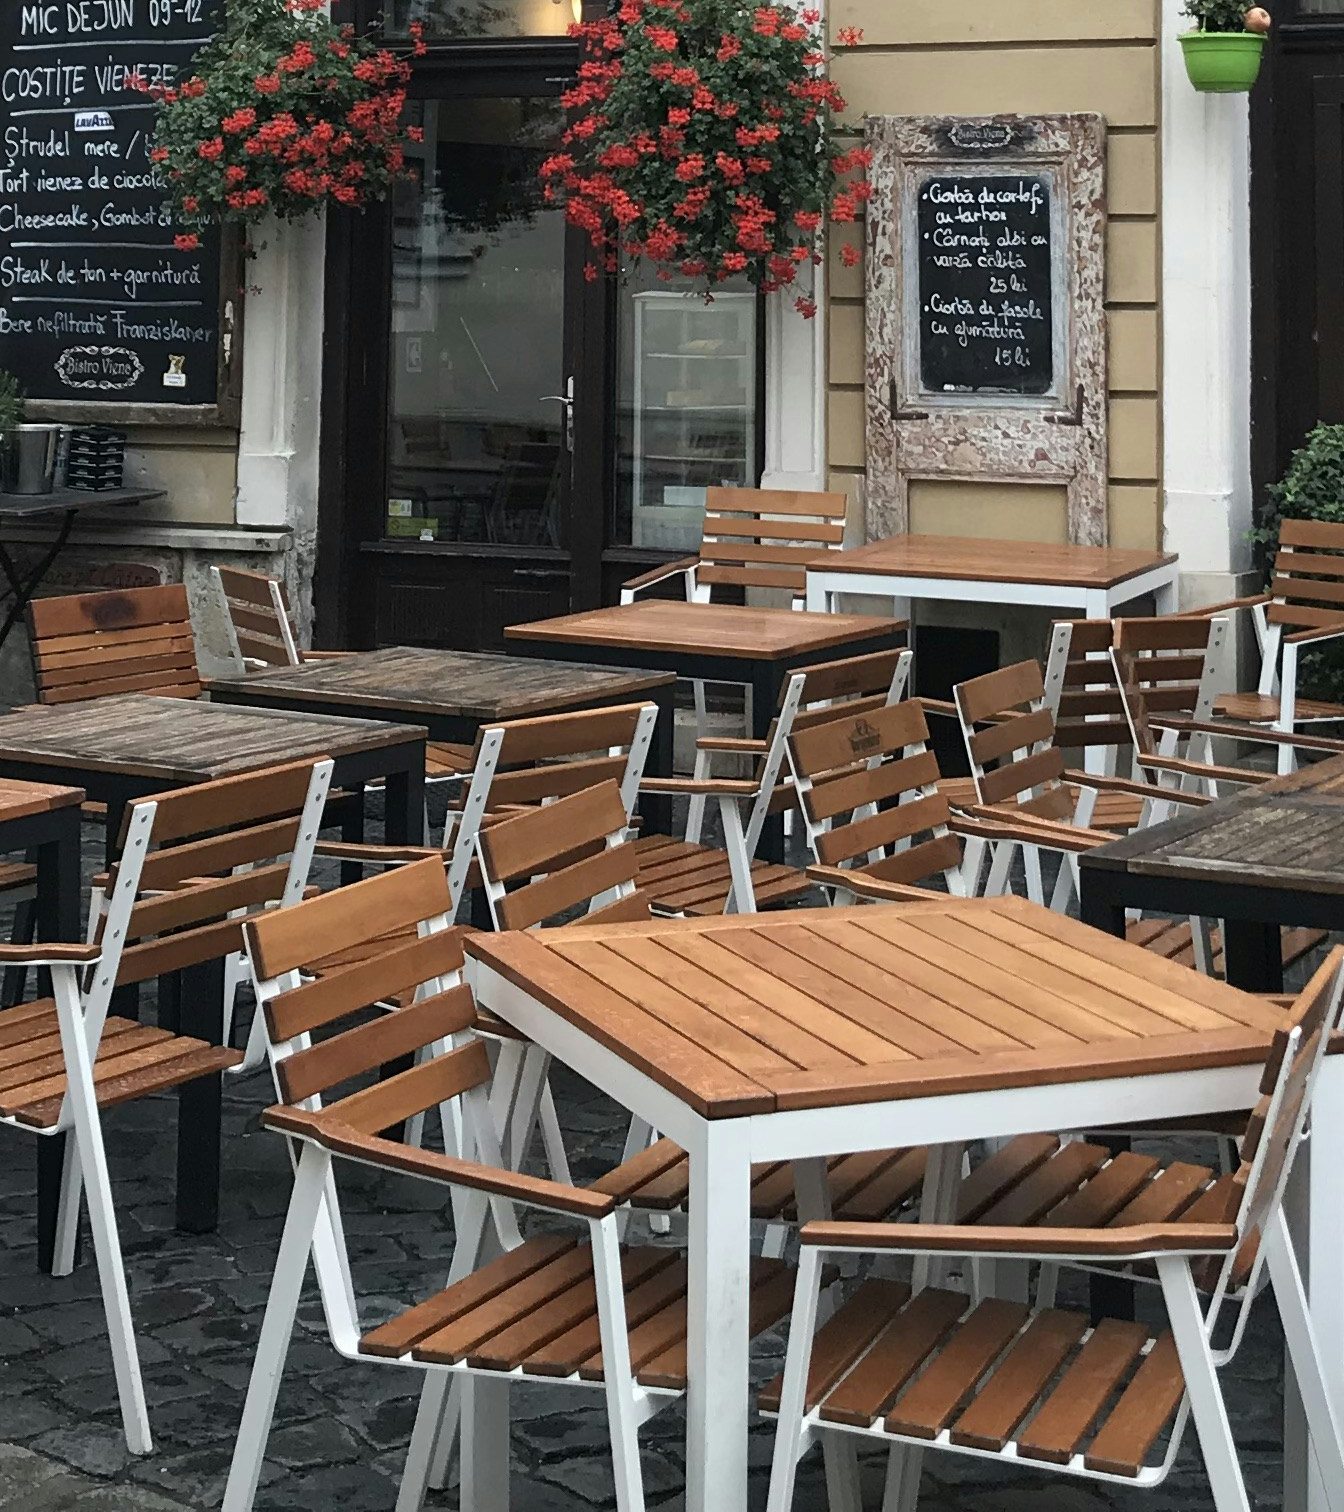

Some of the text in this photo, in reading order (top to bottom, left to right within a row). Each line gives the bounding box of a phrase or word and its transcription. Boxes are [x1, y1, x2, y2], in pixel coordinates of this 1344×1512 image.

[84, 141, 120, 157] mere
[88, 166, 110, 189] de
[113, 169, 168, 189] ciocola
[978, 186, 996, 203] de
[936, 211, 954, 224] cu
[996, 226, 1027, 246] albi
[1030, 235, 1048, 246] cu
[57, 260, 76, 284] de
[80, 258, 106, 283] ton
[989, 273, 1028, 293] 25 lei
[979, 299, 995, 315] de
[110, 310, 213, 343] Franziskaner
[931, 320, 949, 335] cu
[66, 356, 99, 375] Bistro
[995, 346, 1031, 367] 15 lei
